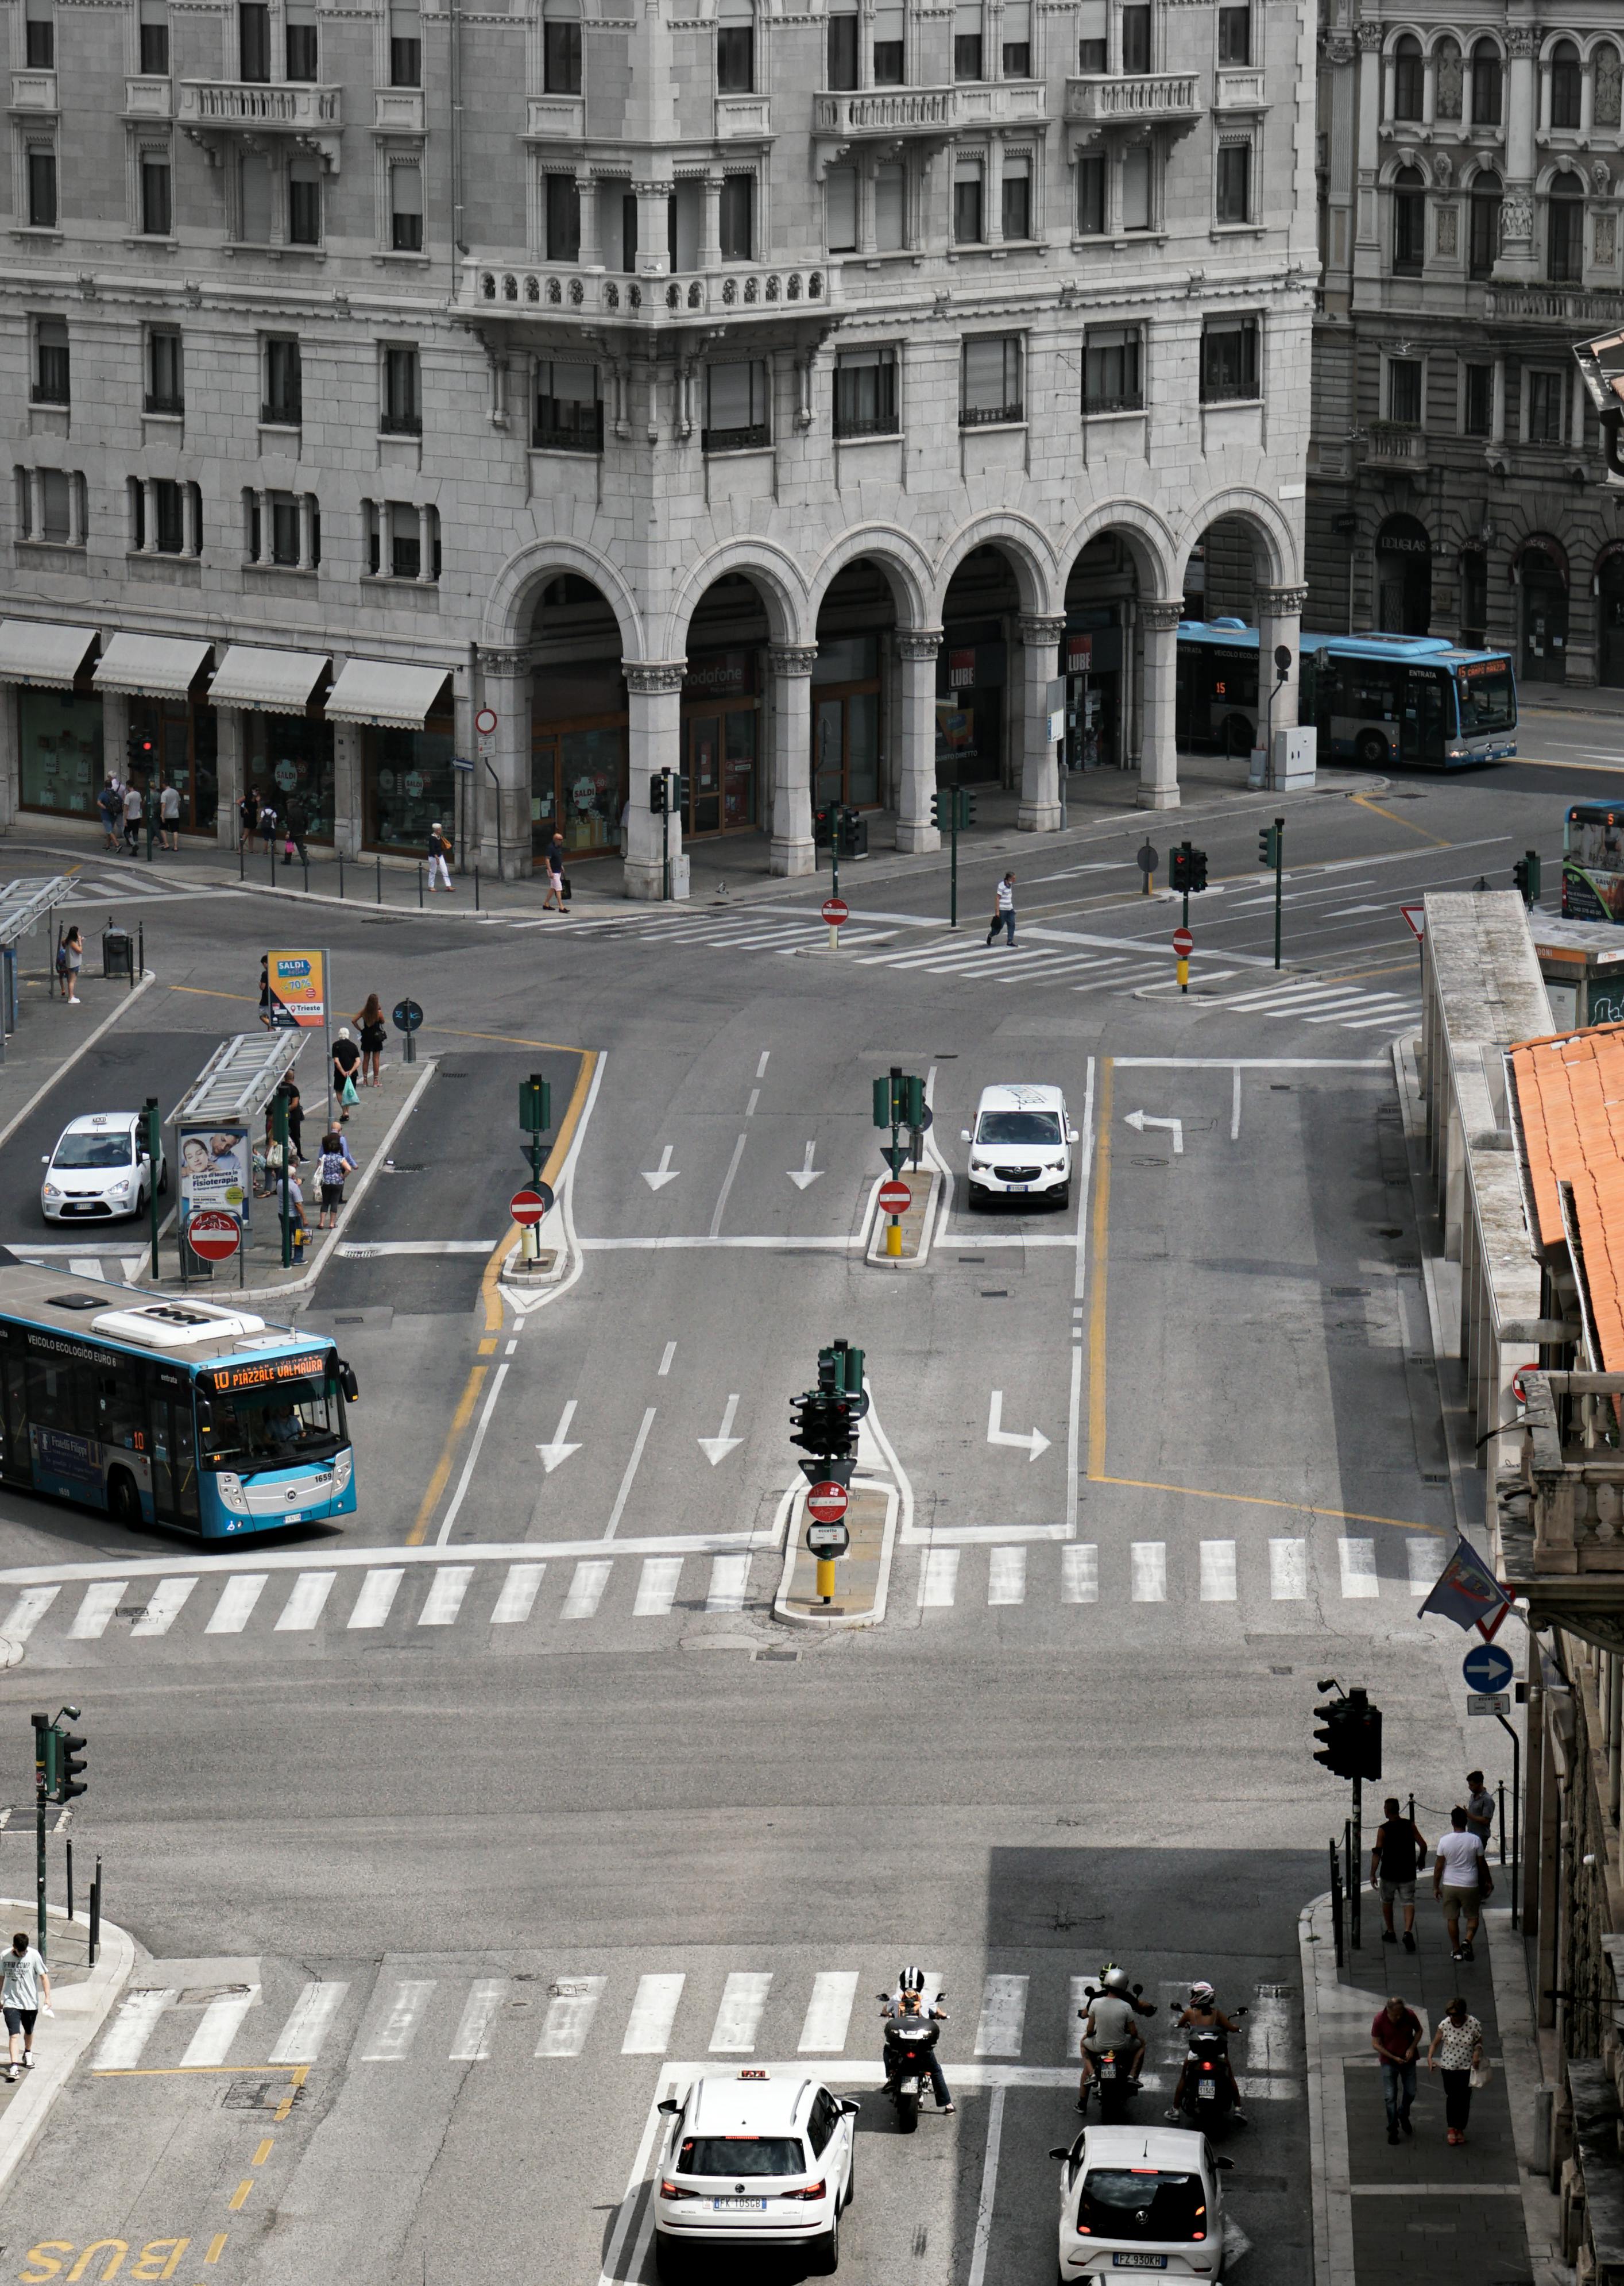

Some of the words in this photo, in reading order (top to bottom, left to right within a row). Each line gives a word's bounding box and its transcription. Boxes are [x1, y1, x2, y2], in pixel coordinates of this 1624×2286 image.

[1382, 536, 1426, 552] DOUGLAS
[1213, 649, 1239, 658] VEICOLO
[1068, 652, 1091, 672] LUBE
[950, 667, 974, 687] LUBE
[1409, 669, 1437, 679] ENTRATA
[1215, 682, 1226, 694] 15
[276, 771, 296, 779] SALDI
[574, 788, 594, 798] SALDI
[279, 961, 304, 970] SALDI
[192, 1176, 238, 1187] Fisioterapia
[28, 1334, 55, 1350] VEICOLO
[56, 1342, 92, 1360] ECOLOGICO
[94, 1351, 111, 1365] EURO
[112, 1357, 117, 1367] 6
[214, 1371, 229, 1390] 10
[233, 1368, 275, 1387] PIAZZALE
[277, 1358, 323, 1378] VALMAURA
[134, 1431, 144, 1450] 10
[315, 1473, 332, 1483] 1659
[720, 2198, 730, 2207] FK
[18, 2238, 191, 2283] BUS
[1120, 2254, 1131, 2264] FZ
[1134, 2255, 1161, 2265] 930KH
